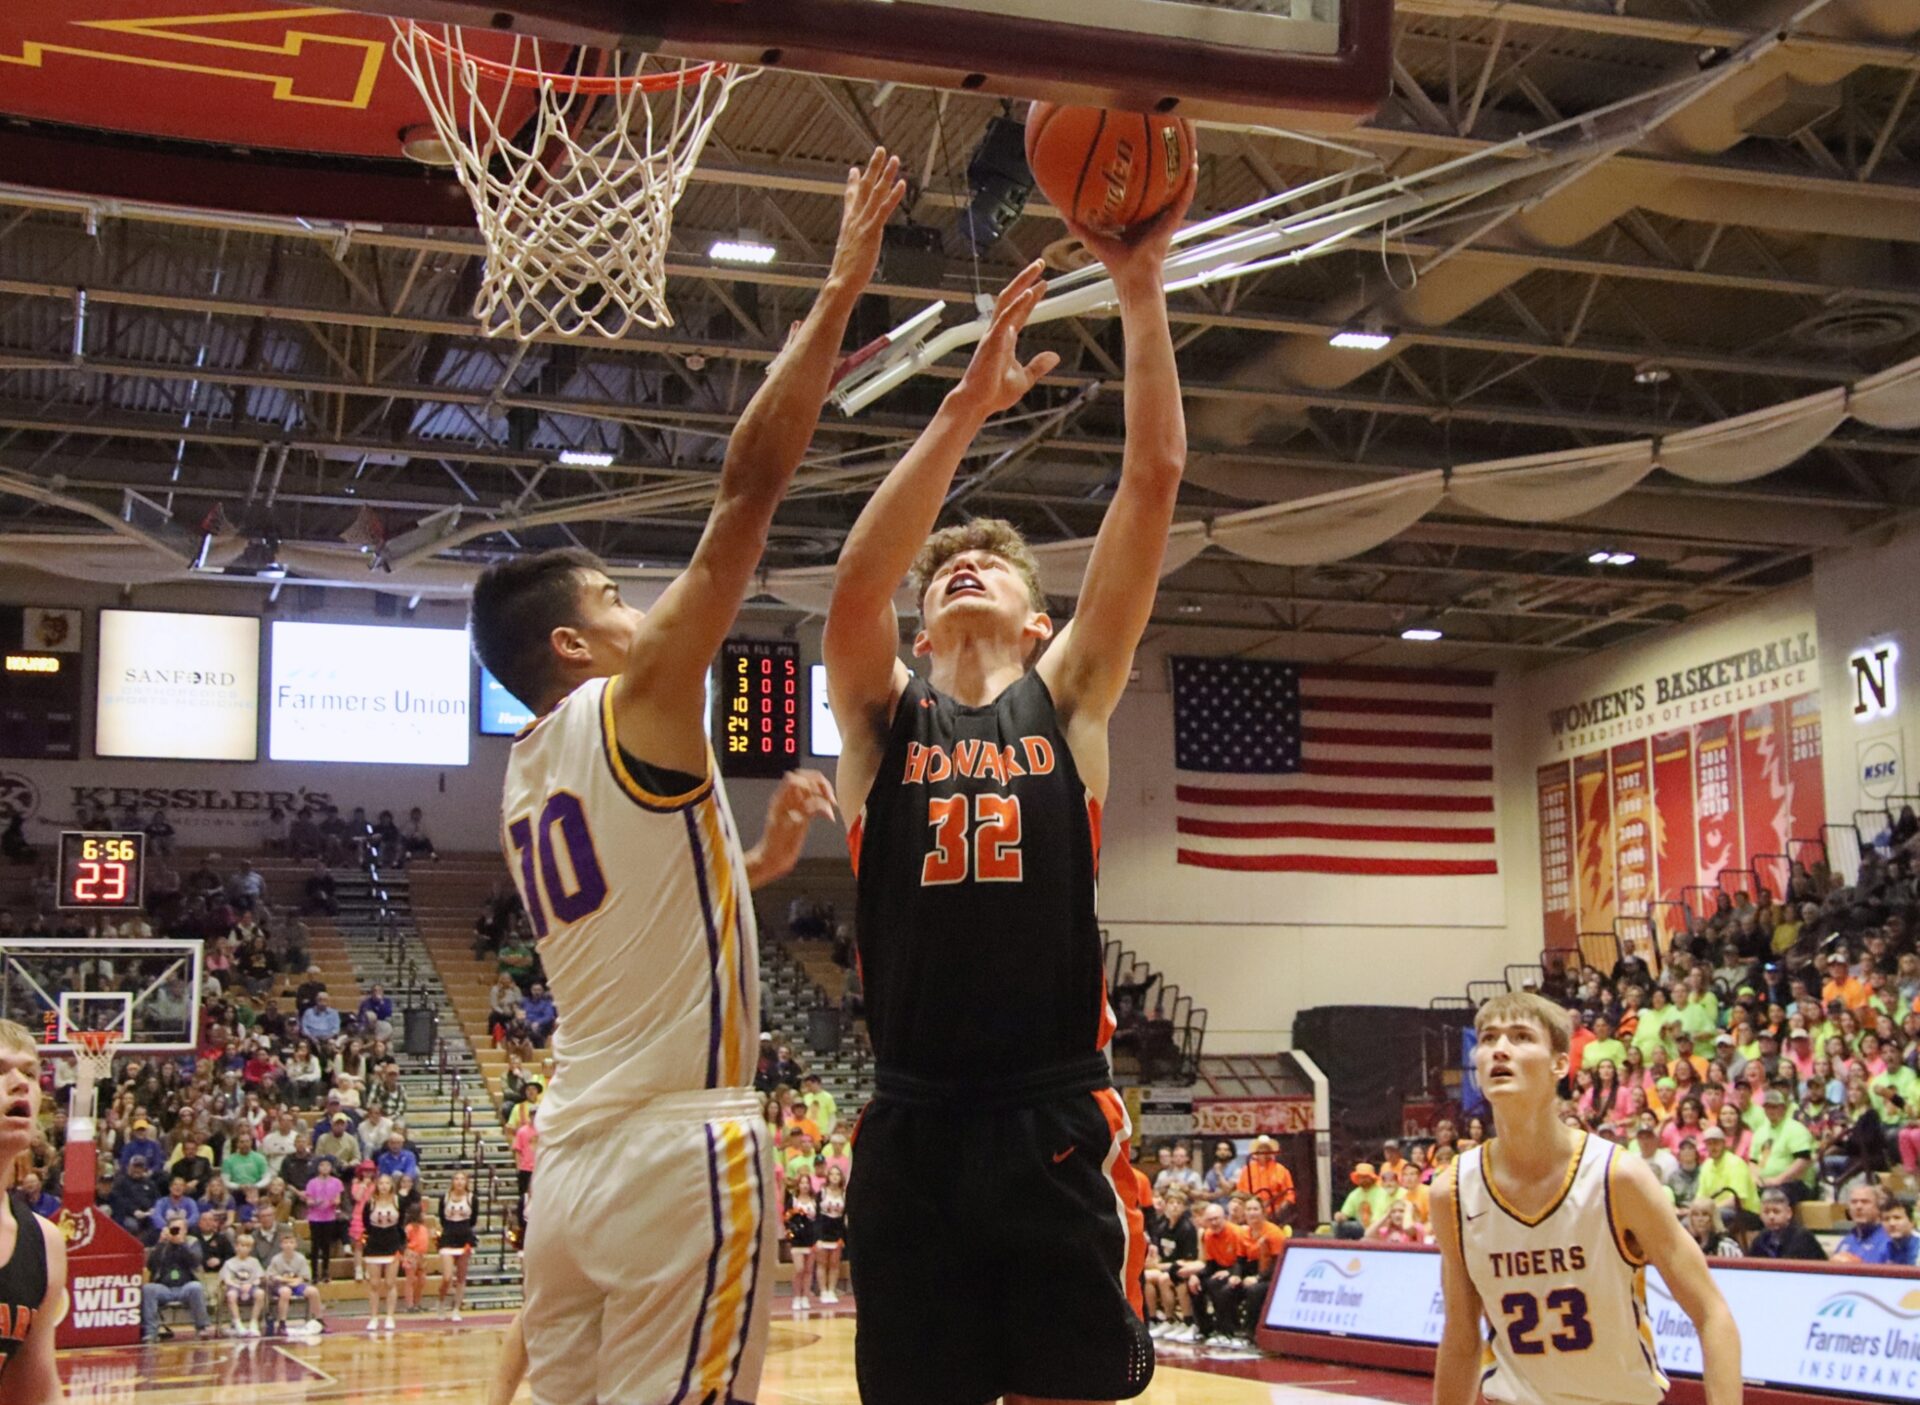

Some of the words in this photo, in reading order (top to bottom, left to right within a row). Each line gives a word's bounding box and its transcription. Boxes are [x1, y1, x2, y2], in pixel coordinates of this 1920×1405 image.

[124, 667, 236, 687] SANFORD
[737, 657, 748, 674] 2
[761, 658, 772, 675] 0
[784, 659, 795, 676] 5
[738, 677, 748, 693] 3
[761, 678, 772, 694] 0
[784, 679, 795, 695] 0
[1549, 683, 1646, 736] WOMEN'S
[1655, 632, 1817, 705] BASKETBALL
[1851, 649, 1889, 716] N
[277, 684, 387, 713] Farmers
[394, 689, 466, 716] Union
[733, 696, 749, 713] 10
[761, 697, 772, 713] 0
[784, 698, 795, 714] 0
[1569, 712, 1655, 749] TRADITION
[1662, 704, 1681, 723] OF
[1690, 669, 1806, 715] EXCELLENCE
[727, 716, 749, 732] 24
[761, 717, 772, 733] 0
[784, 718, 795, 734] 2
[728, 735, 749, 752] 32
[761, 736, 772, 753] 0
[784, 737, 795, 754] 0
[1700, 747, 1728, 769] 2014
[901, 735, 1056, 787] HOWARD
[1700, 764, 1728, 784] 2015
[70, 785, 331, 812] KESSLER'S
[82, 838, 135, 861] 6:56
[920, 792, 1023, 888] 32
[507, 789, 610, 941] 10
[74, 861, 127, 901] 23
[1489, 1245, 1587, 1278] TIGERS
[73, 1273, 143, 1291] BUFFALO
[1296, 1281, 1335, 1305] Farmers
[1335, 1284, 1364, 1308] Union
[73, 1287, 142, 1312] WILD
[73, 1308, 142, 1329] WINGS
[1290, 1309, 1358, 1328] INSURANCE
[1500, 1286, 1595, 1356] 23
[1805, 1322, 1882, 1356] Farmers
[1798, 1359, 1918, 1389] INSURANC
